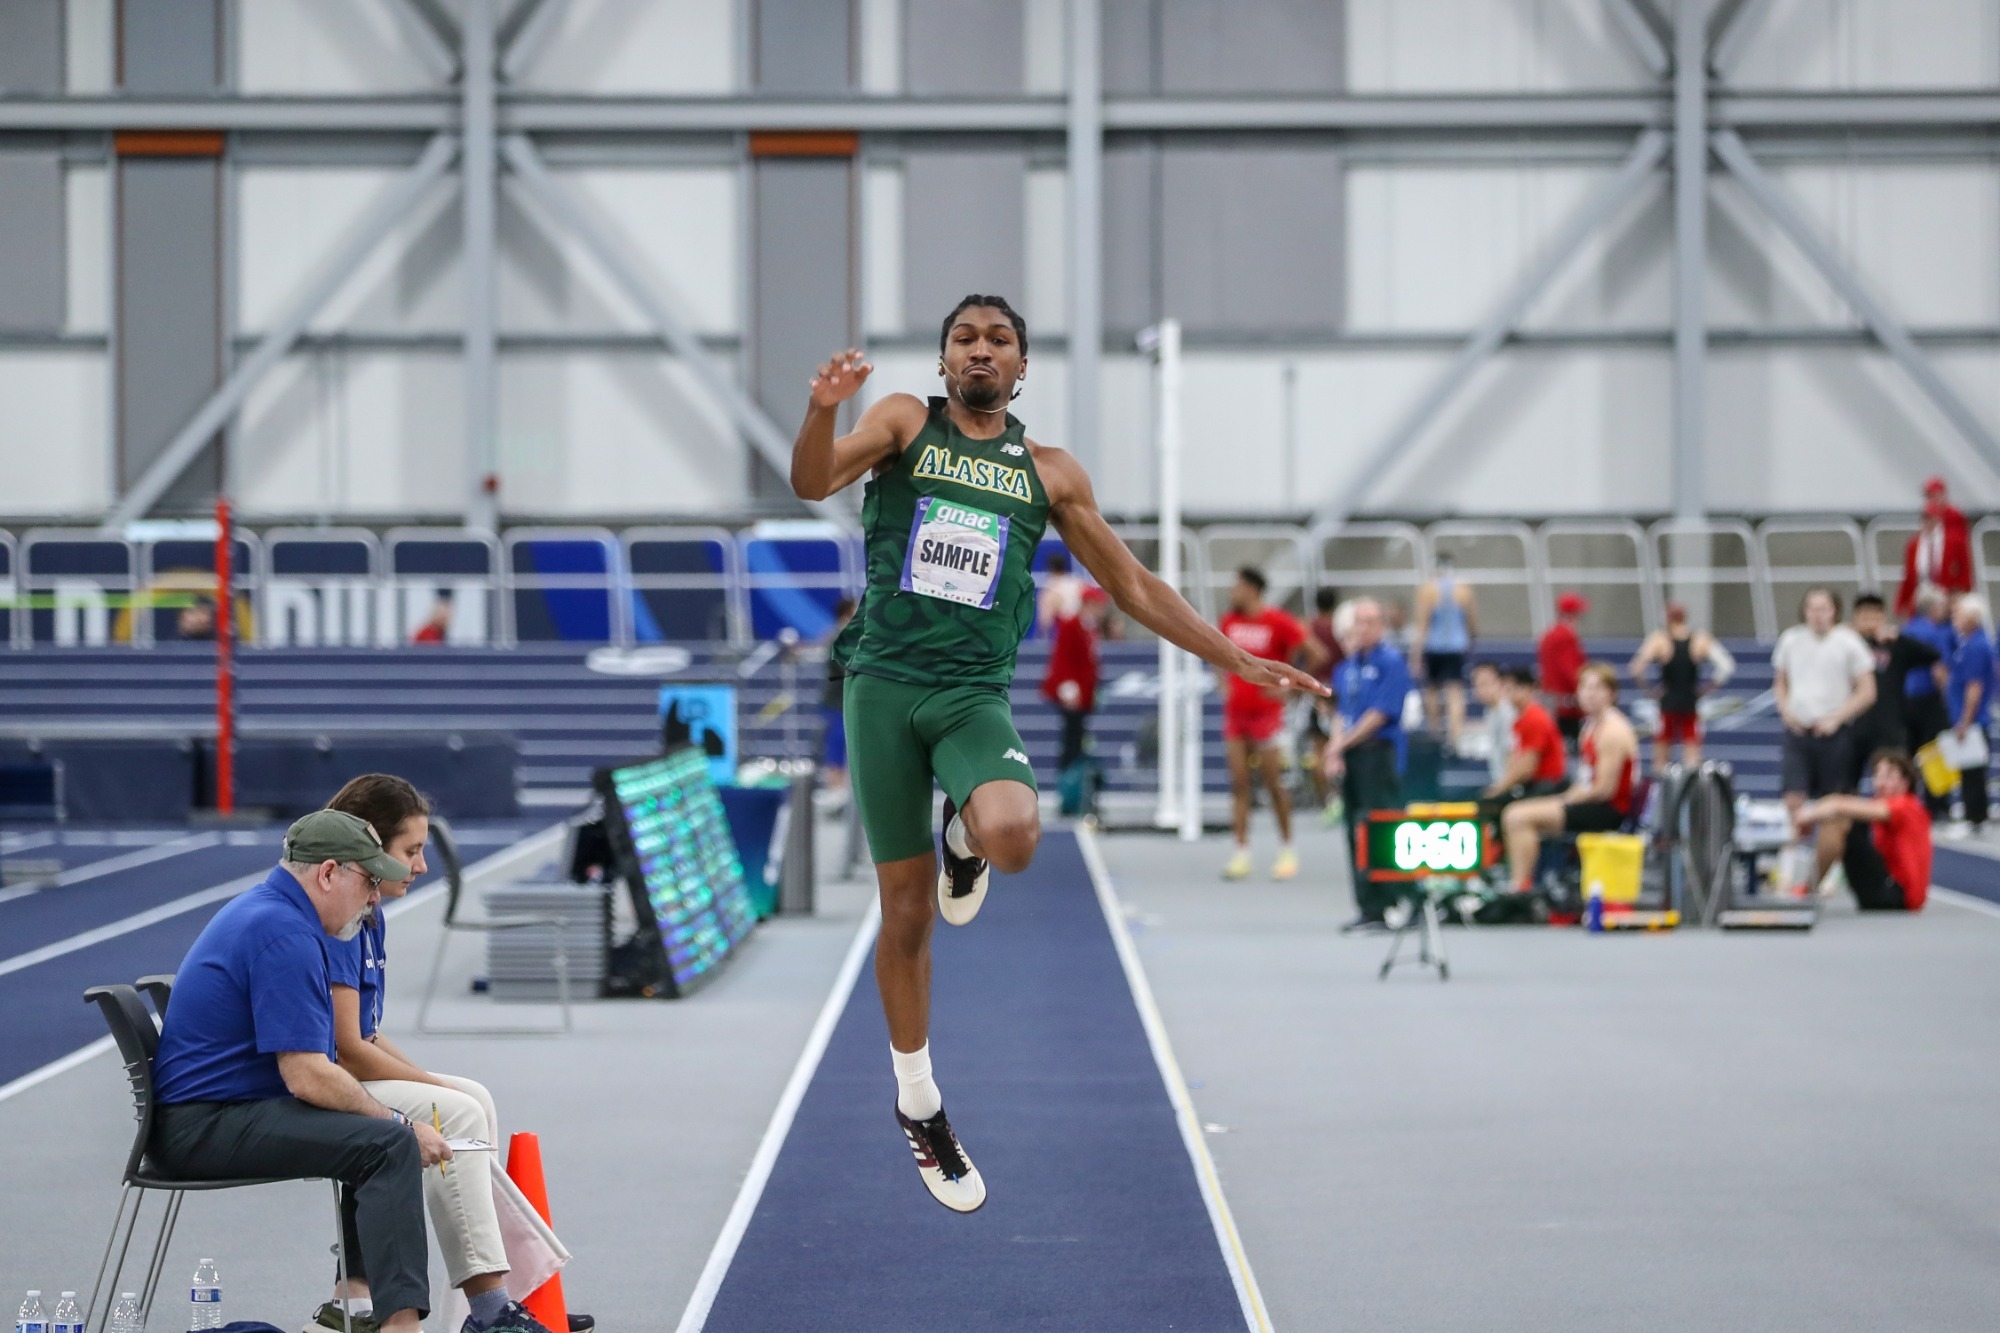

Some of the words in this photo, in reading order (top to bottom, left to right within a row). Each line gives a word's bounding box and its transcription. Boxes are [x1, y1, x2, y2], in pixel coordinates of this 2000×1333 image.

[913, 444, 1032, 504] ALASKA
[934, 505, 991, 530] gnac
[920, 539, 991, 577] SAMPLE
